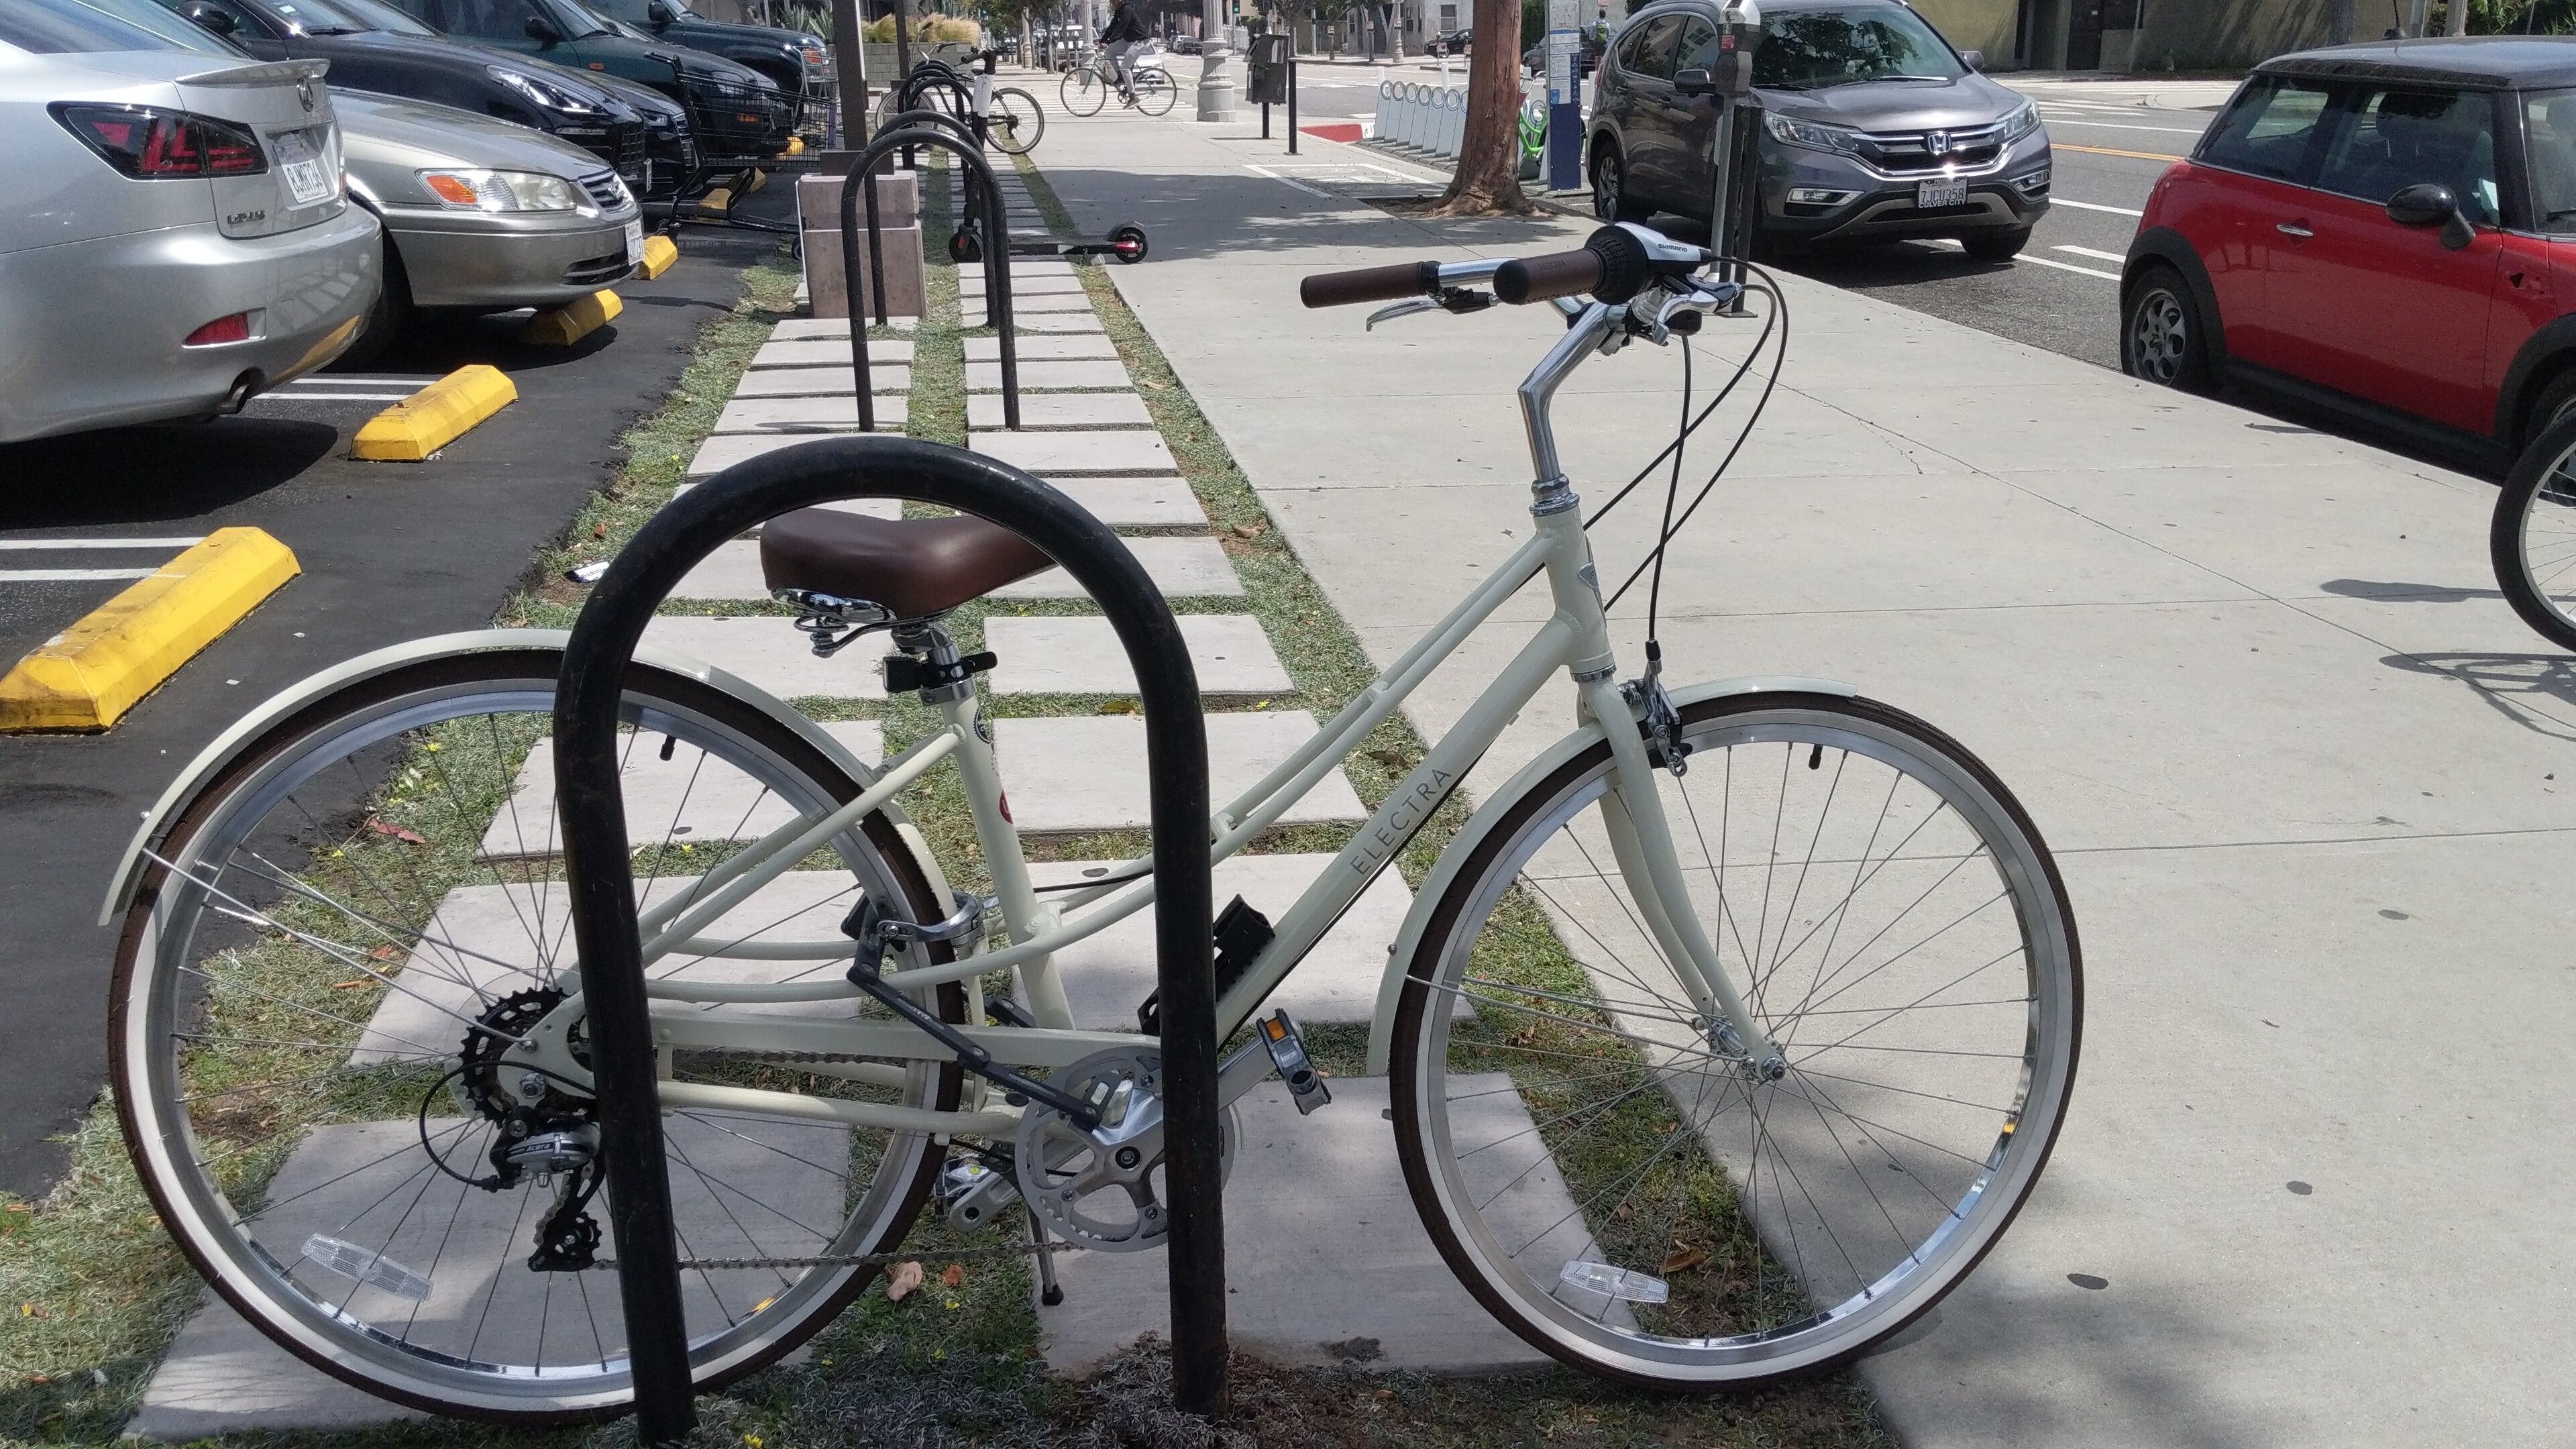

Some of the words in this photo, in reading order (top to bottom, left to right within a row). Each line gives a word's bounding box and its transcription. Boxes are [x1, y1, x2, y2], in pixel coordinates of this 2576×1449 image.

[1921, 188, 1964, 203] 7JCU358
[1658, 244, 1688, 252] SHIMANO
[1350, 769, 1451, 875] ELECTRA
[526, 1143, 551, 1152] Acora
